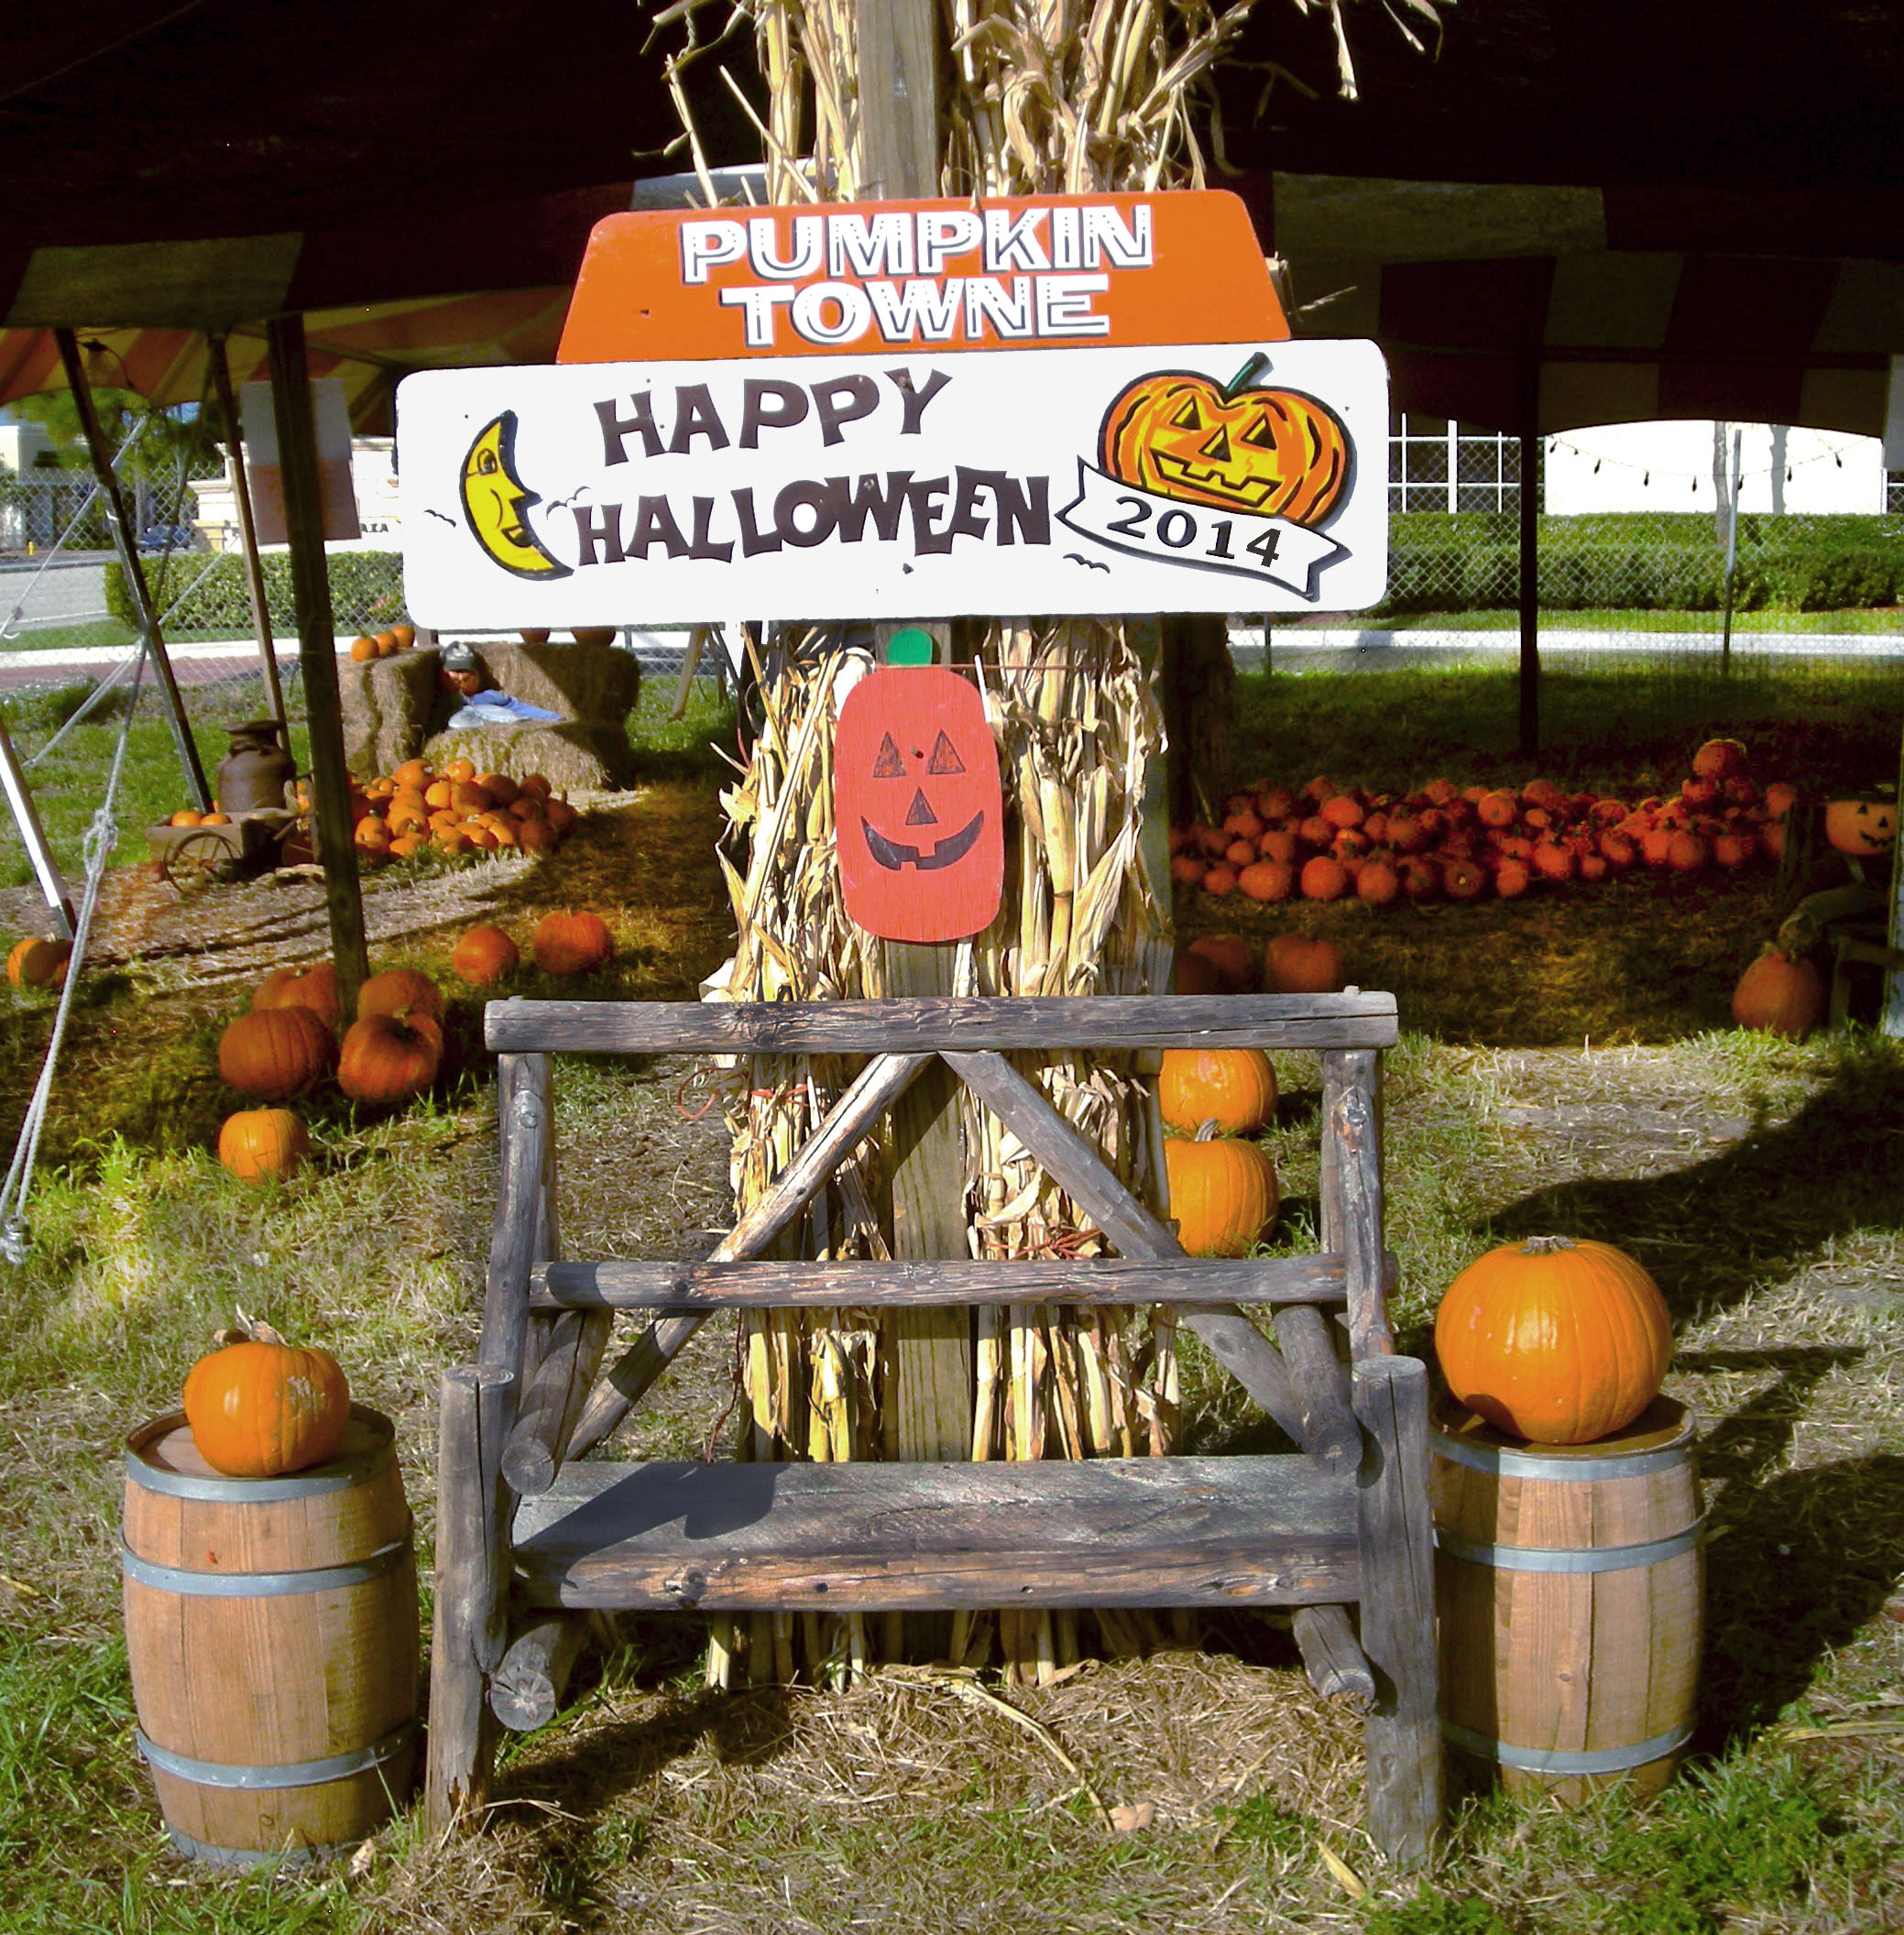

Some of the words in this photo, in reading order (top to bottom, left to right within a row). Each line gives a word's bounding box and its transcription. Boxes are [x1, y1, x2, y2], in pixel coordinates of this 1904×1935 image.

[680, 203, 1154, 286] PUMPKIN
[719, 273, 1111, 348] TOWNE
[594, 367, 953, 466] HAPPY
[578, 465, 1051, 564] HALLOWEEN
[1106, 496, 1281, 568] 2014
